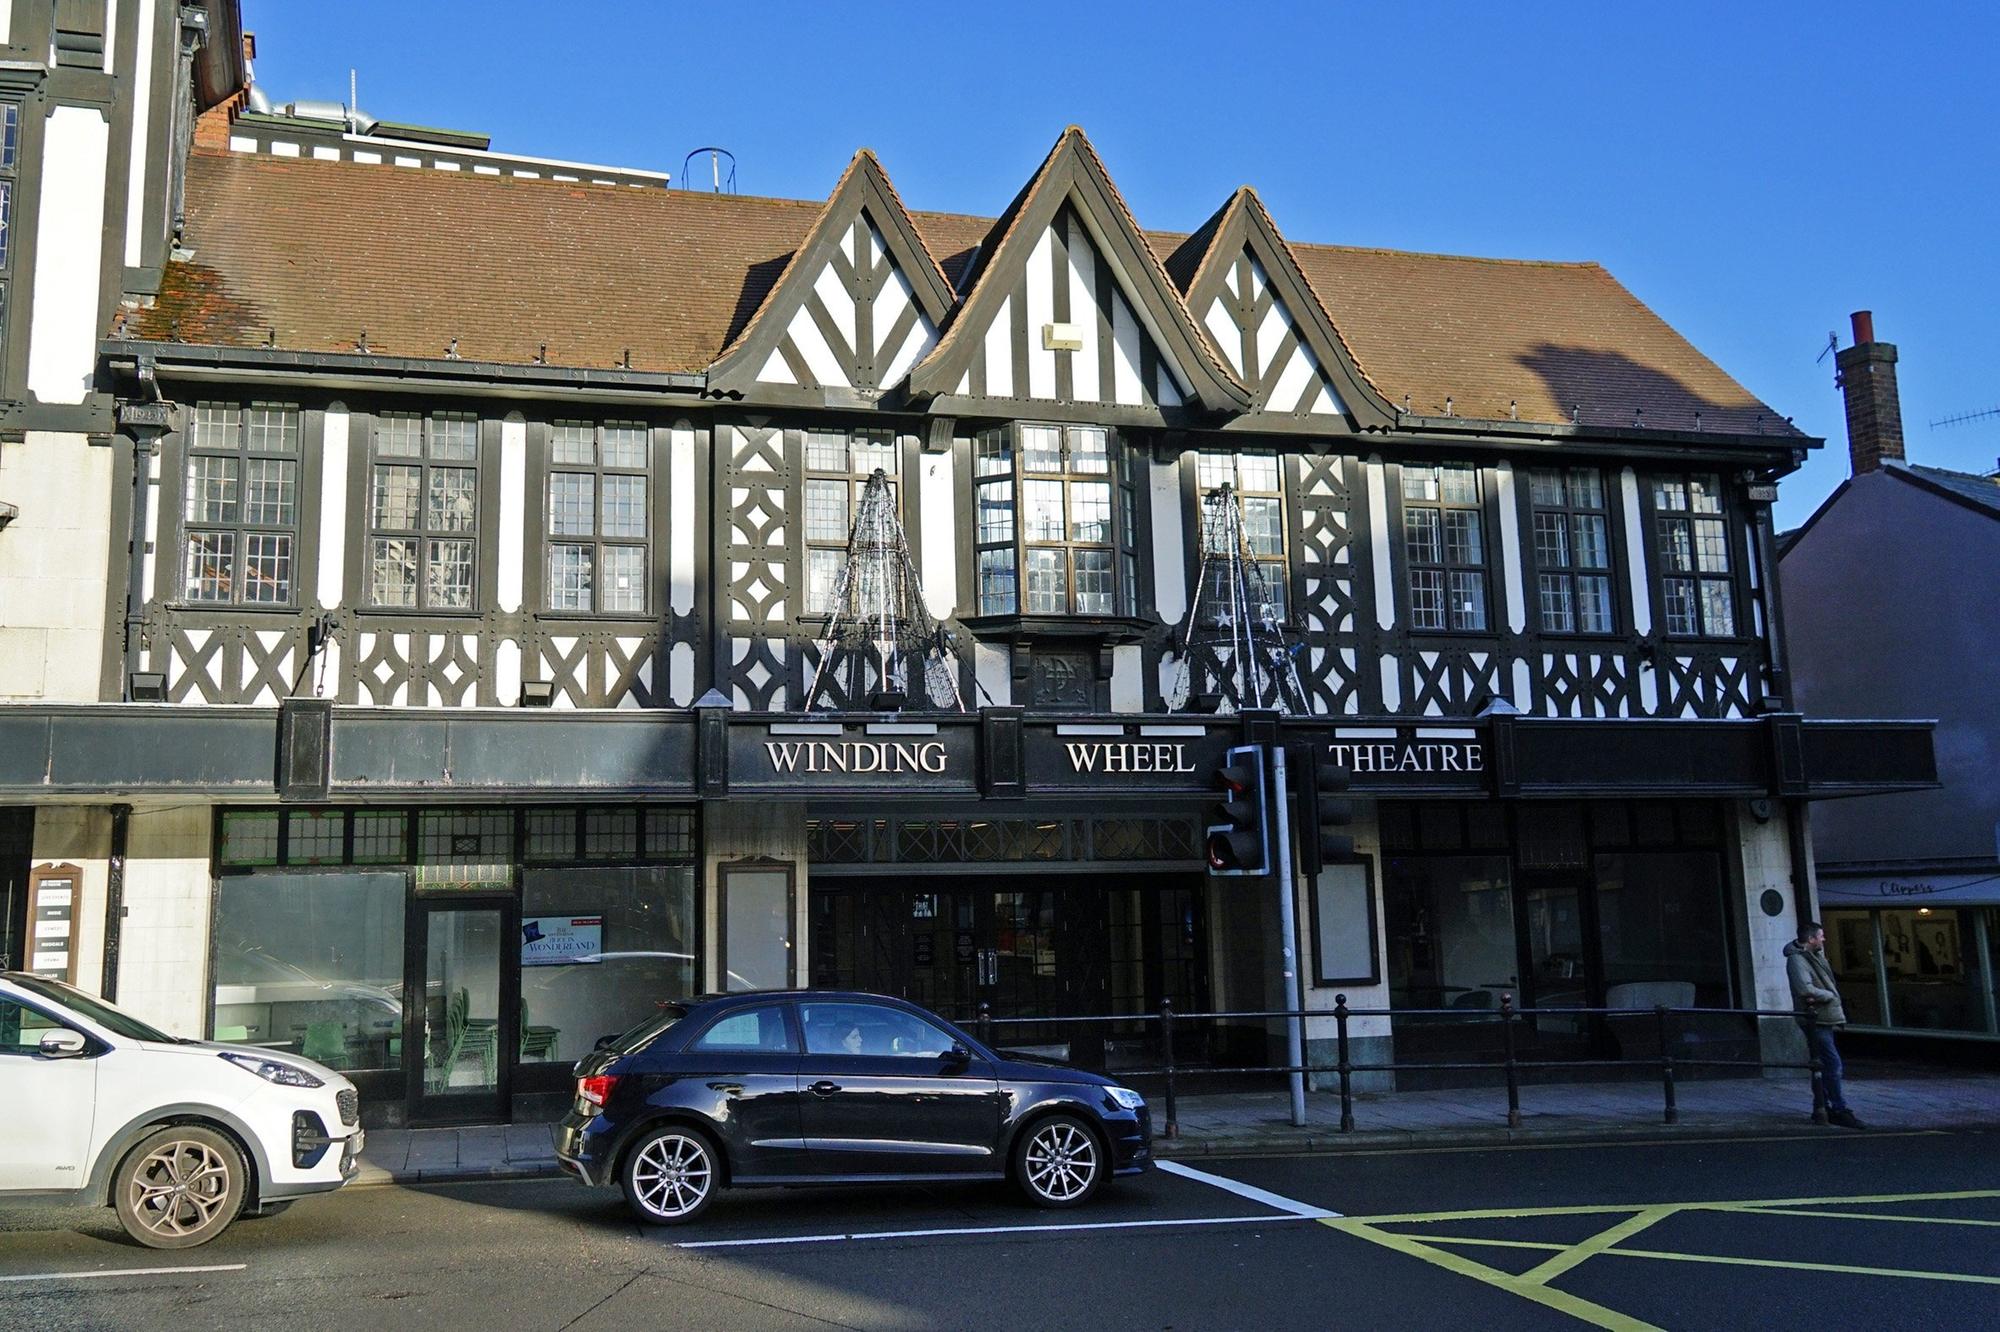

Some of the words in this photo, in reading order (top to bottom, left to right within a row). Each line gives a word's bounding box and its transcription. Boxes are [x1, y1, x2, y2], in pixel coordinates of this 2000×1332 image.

[764, 742, 948, 773] WINDING
[1065, 743, 1196, 772] WHEEL
[1328, 744, 1484, 772] THEATRE
[1880, 881, 1935, 896] Clippers
[529, 941, 595, 952] WONDERLAND
